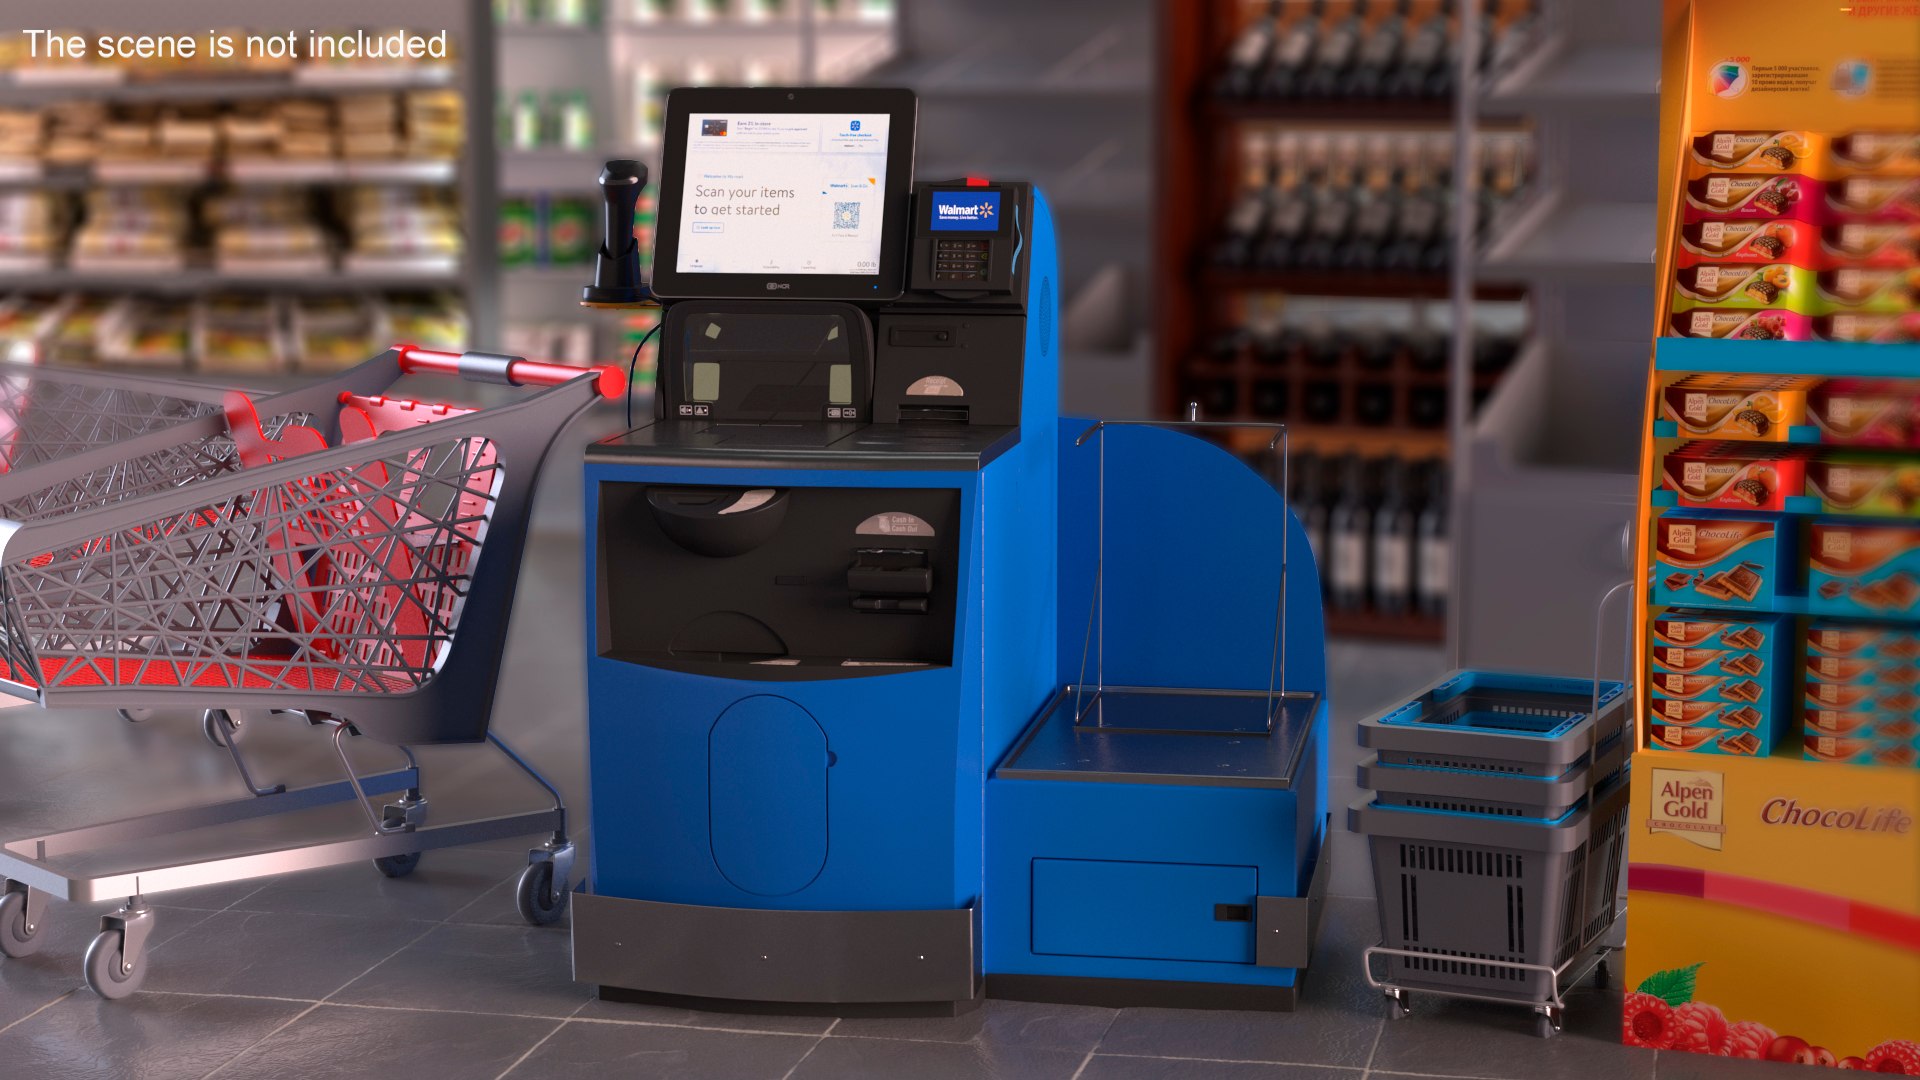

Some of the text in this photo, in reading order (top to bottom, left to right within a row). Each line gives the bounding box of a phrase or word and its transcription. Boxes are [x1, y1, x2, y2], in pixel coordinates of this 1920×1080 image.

[695, 185, 795, 201] Scan your items
[694, 204, 780, 216] to get started
[938, 204, 978, 215] Walmart
[1688, 404, 1703, 412] Gold
[1686, 467, 1703, 475] Alpen
[1672, 529, 1693, 538] Alpen
[1699, 529, 1742, 539] ChocoLife
[1660, 780, 1713, 803] Alpen
[1663, 800, 1708, 819] Gold
[1760, 797, 1913, 834] ChocoLife
